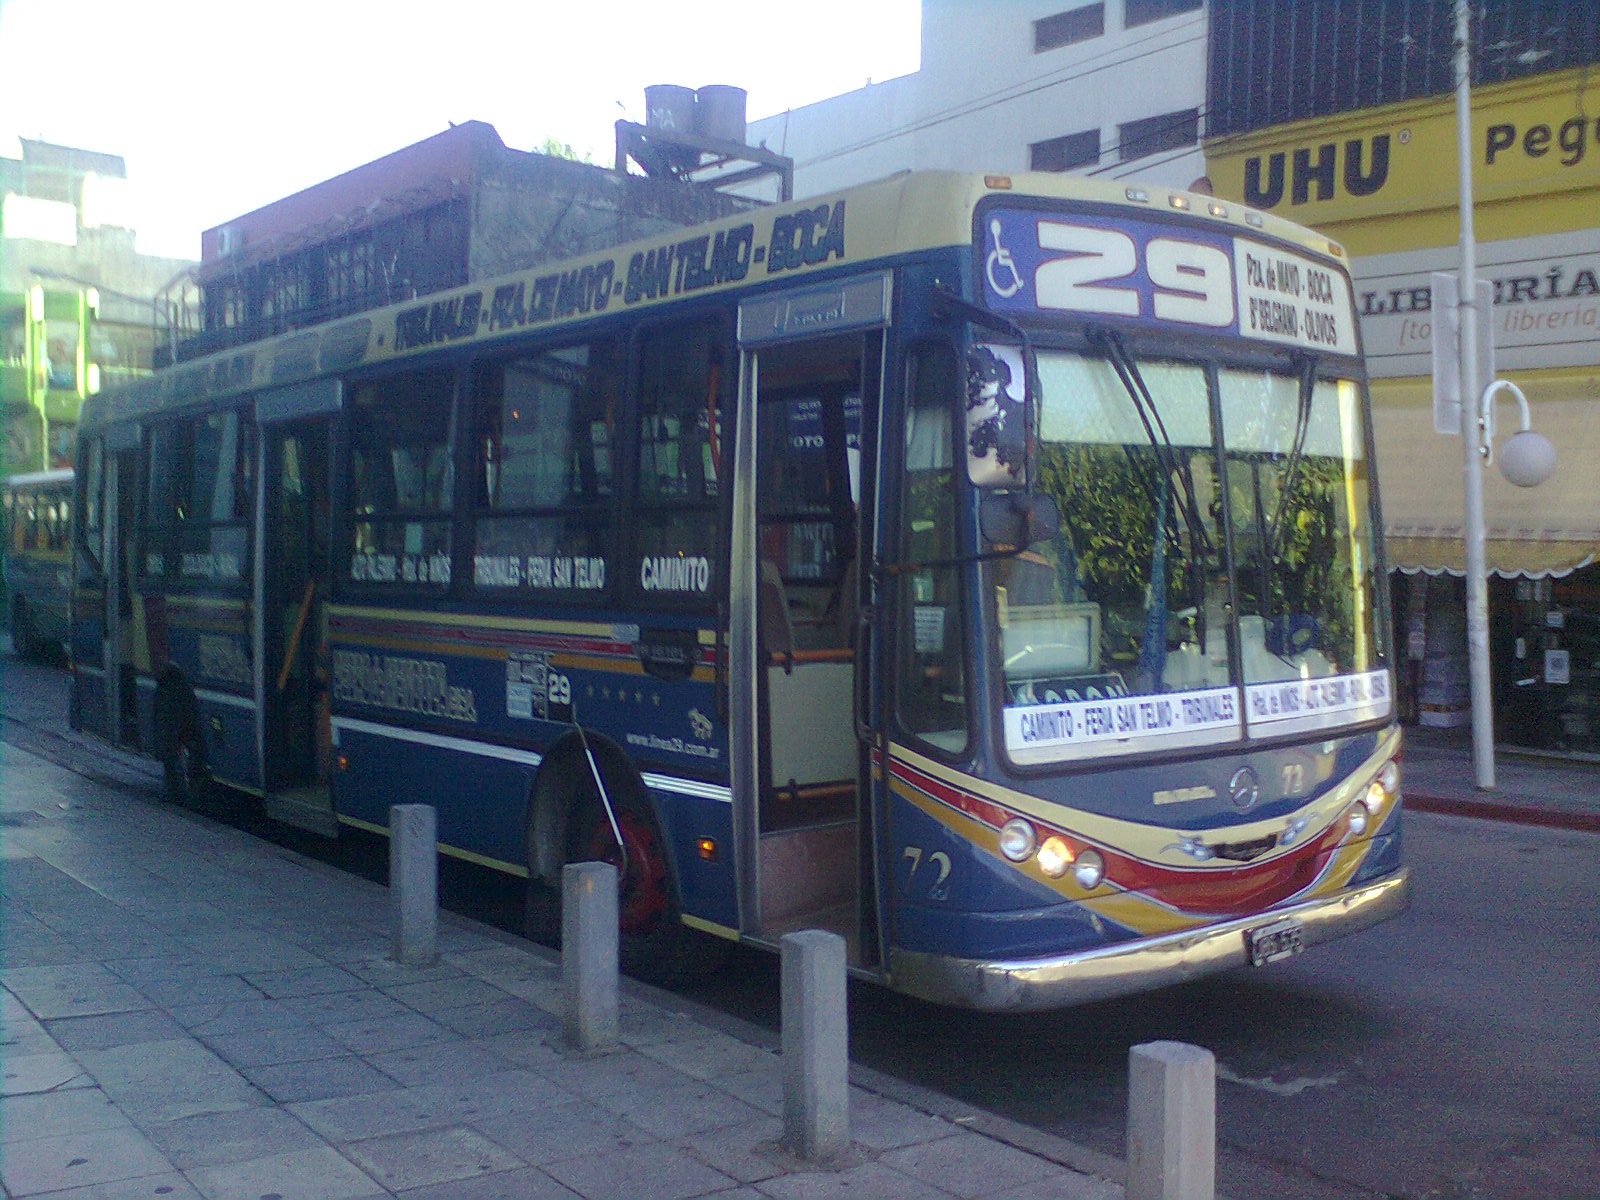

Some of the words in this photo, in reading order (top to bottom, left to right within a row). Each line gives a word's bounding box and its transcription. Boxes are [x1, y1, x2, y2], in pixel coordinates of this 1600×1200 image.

[1485, 115, 1600, 167] Peg
[1243, 133, 1391, 209] UHU
[624, 244, 676, 304] SAN
[673, 223, 755, 294] TELMO
[767, 199, 846, 275] BOCA
[1035, 220, 1235, 328] 29
[1276, 259, 1300, 298] MAYO
[1307, 268, 1333, 305] BOCA
[1360, 265, 1600, 316] LIBRÍA
[1258, 298, 1298, 339] BELGRANO
[1304, 307, 1337, 347] OLIVOS
[553, 556, 572, 589] SAN
[573, 556, 605, 590] TELMO
[640, 555, 710, 592] CAMINITO
[548, 672, 571, 706] 29
[1020, 709, 1074, 742] CAMINITO
[1085, 706, 1115, 736] FERIA
[1116, 703, 1138, 732] SAN
[1138, 700, 1173, 731] TELMO
[1181, 693, 1235, 725] TRIBUNALES
[1282, 763, 1304, 796] 72
[903, 846, 952, 900] 72
